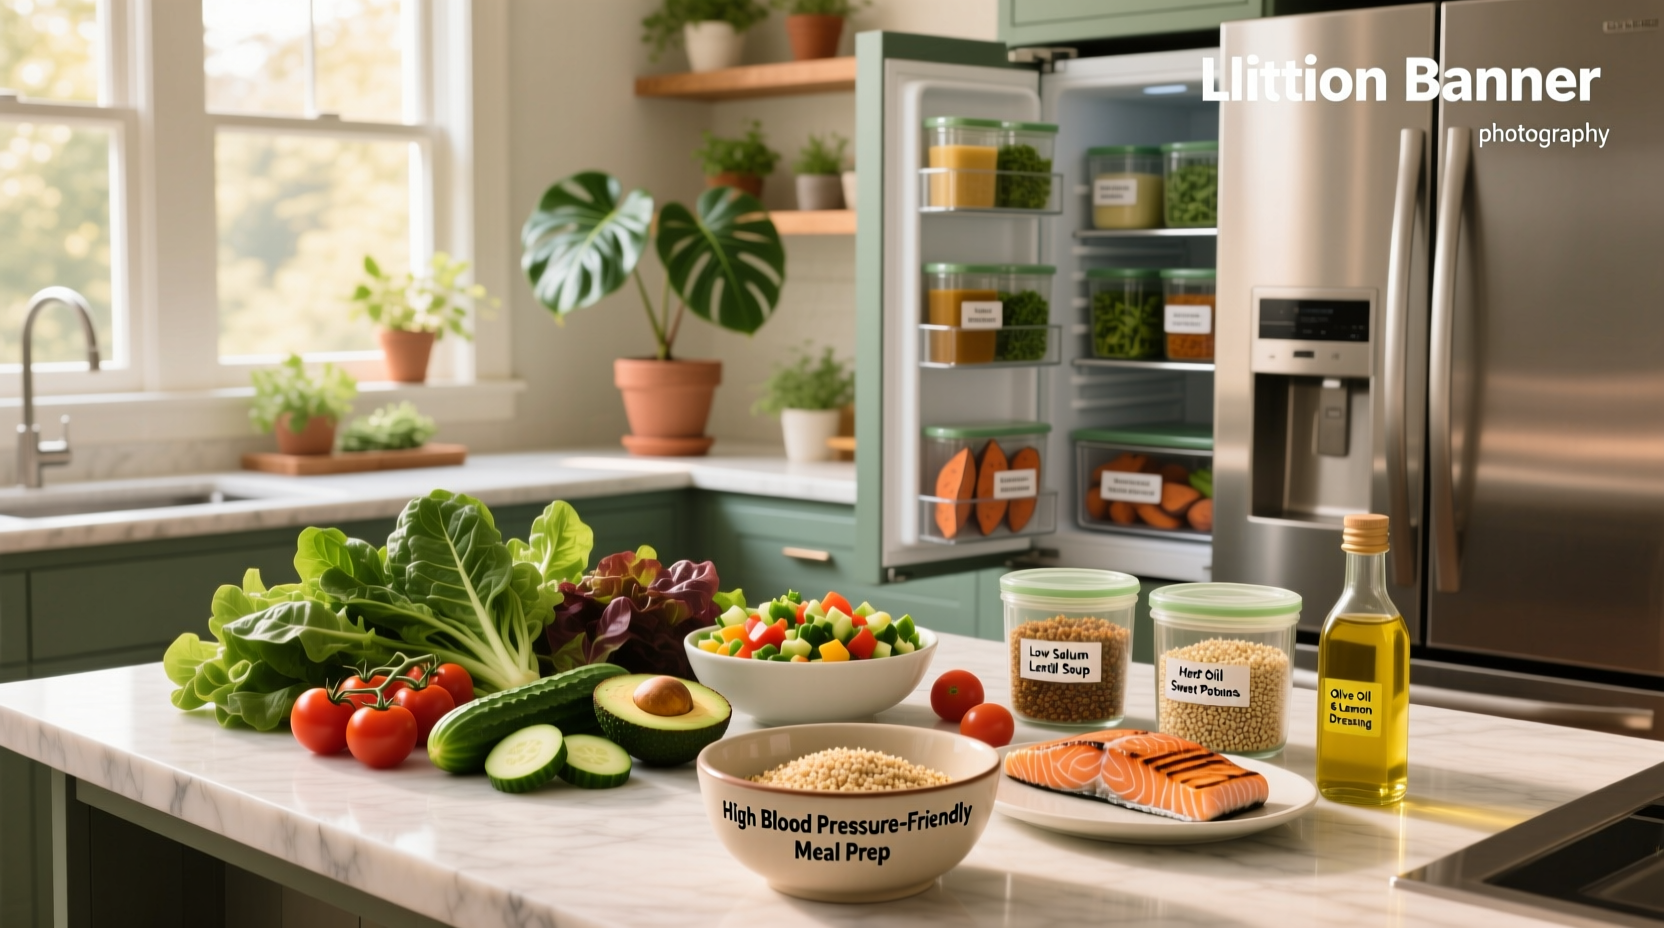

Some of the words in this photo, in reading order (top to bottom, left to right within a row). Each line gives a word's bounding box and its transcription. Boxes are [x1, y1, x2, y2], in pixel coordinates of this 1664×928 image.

[1029, 645, 1050, 658] Low
[1062, 663, 1091, 679] Soup
[1357, 690, 1372, 703] Oil
[723, 800, 756, 830] High
[761, 809, 812, 833] Blood
[817, 801, 972, 835] Pressure-Friendly
[795, 840, 840, 861] Meal
[846, 842, 891, 866] Prep
